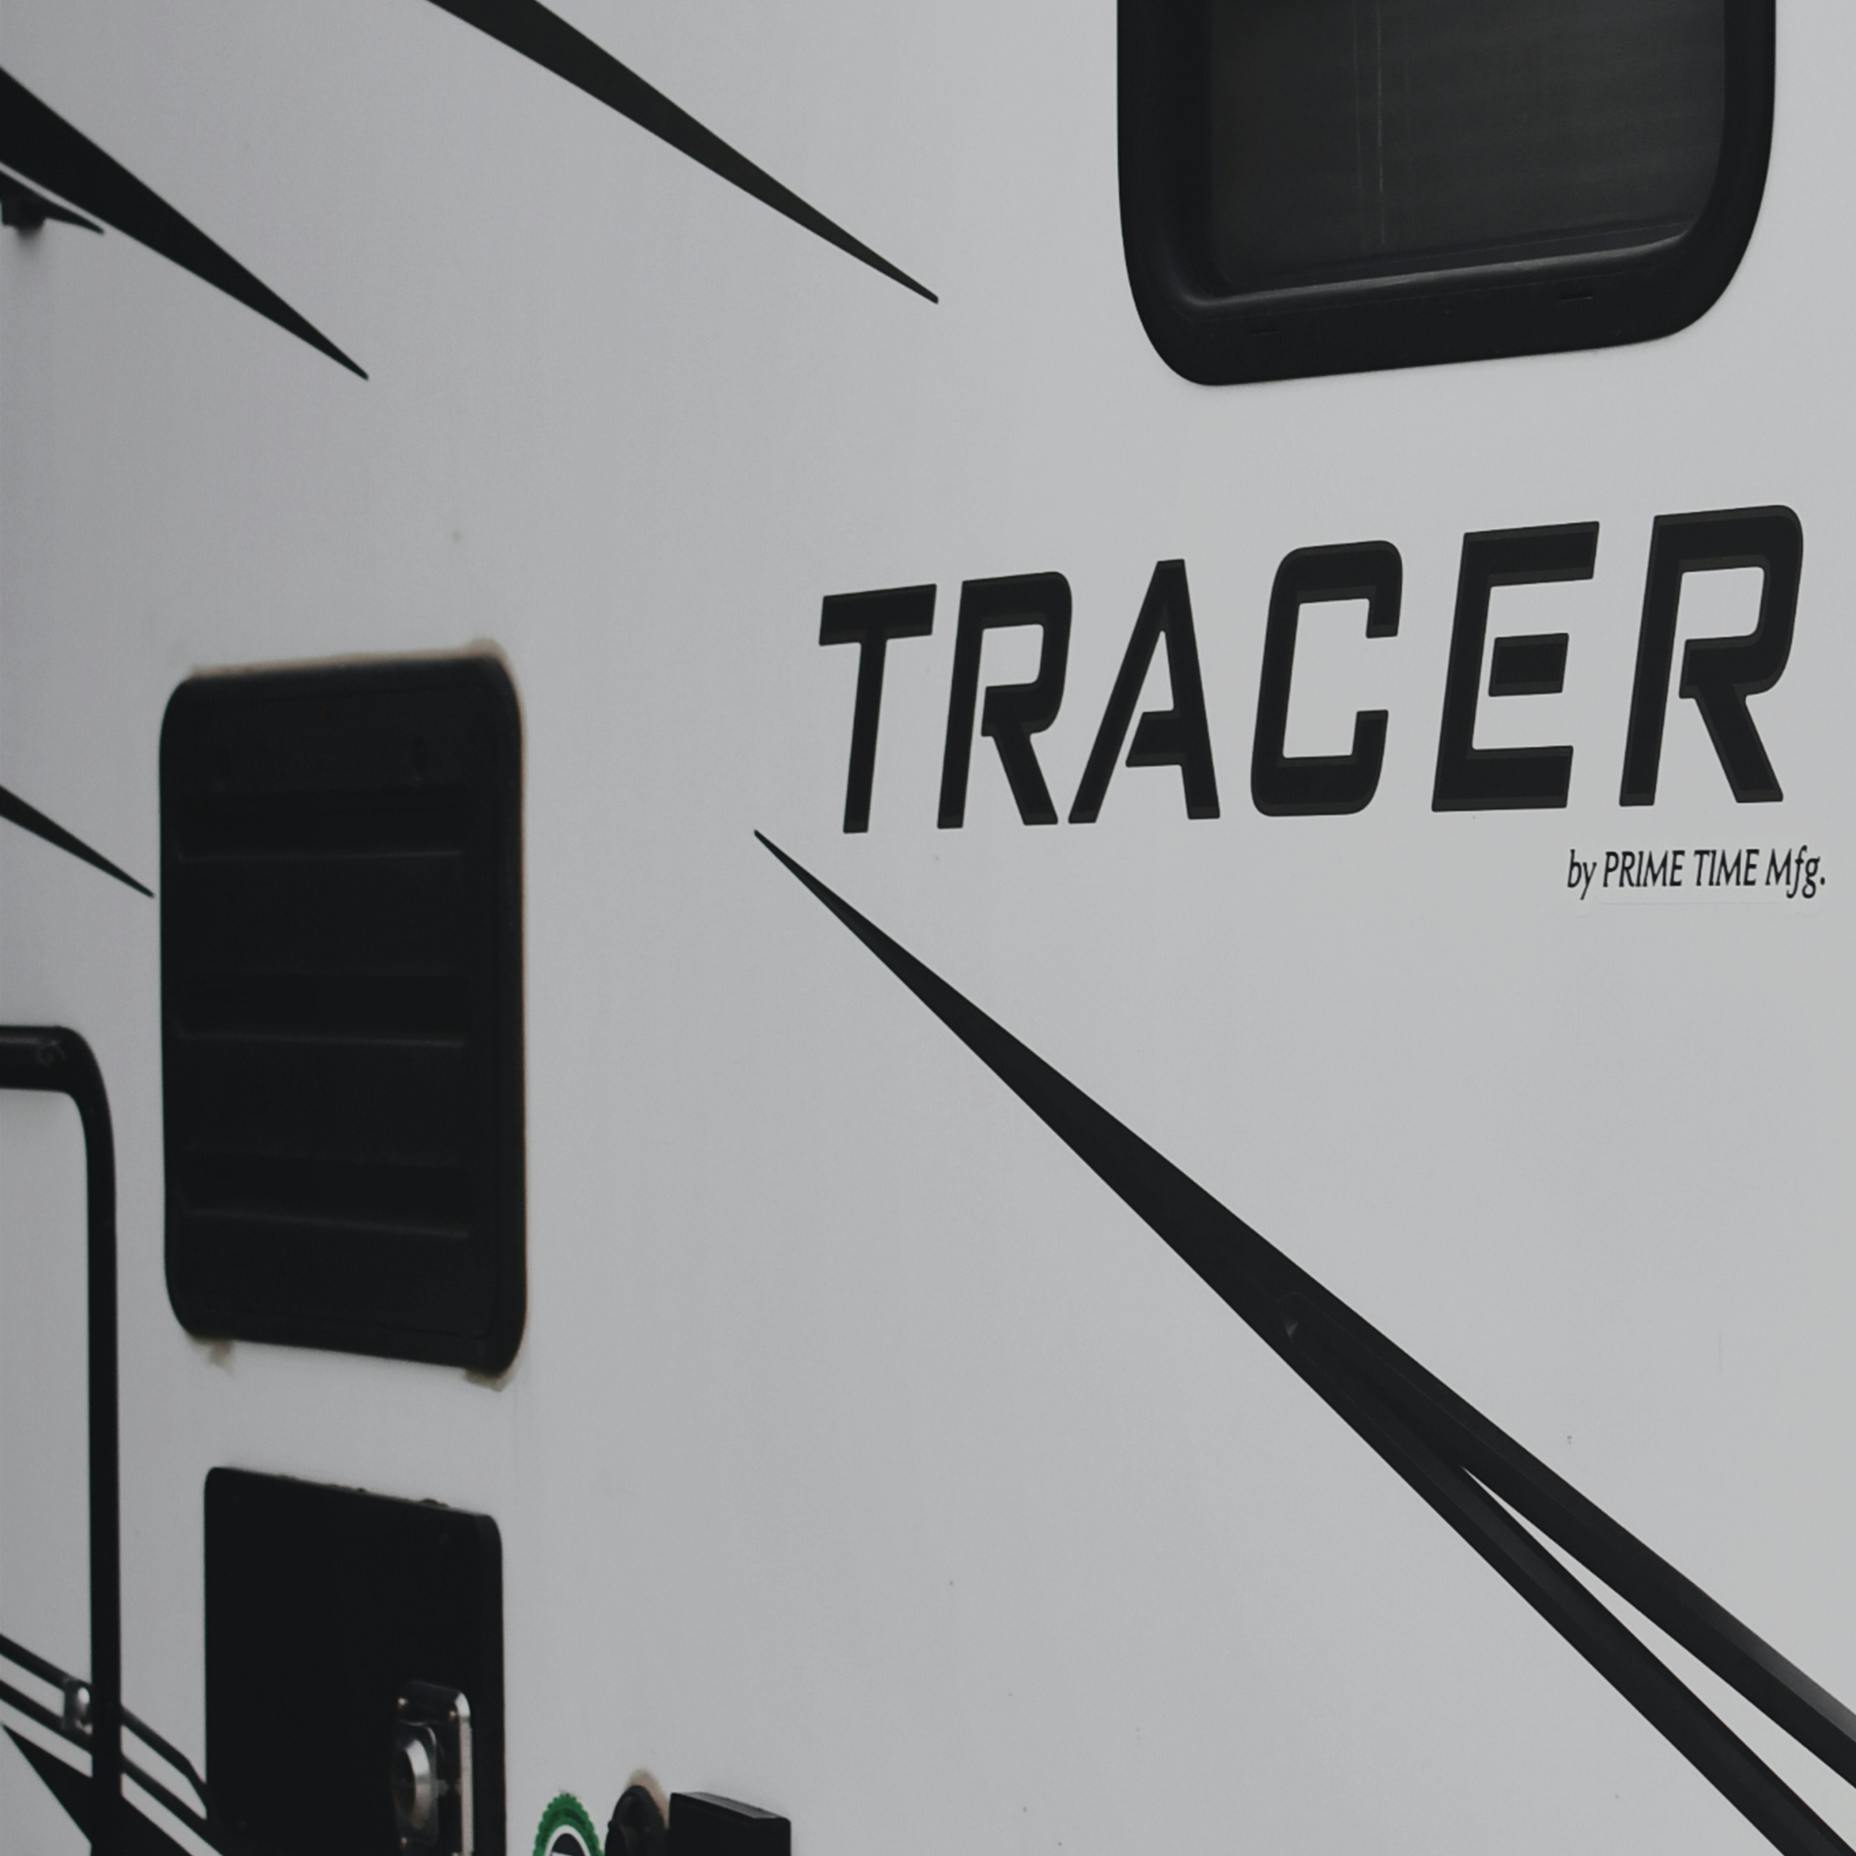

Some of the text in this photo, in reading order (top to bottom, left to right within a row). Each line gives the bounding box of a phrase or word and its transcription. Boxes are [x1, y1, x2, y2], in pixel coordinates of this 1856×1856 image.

[819, 505, 1803, 834] TRACER
[1567, 844, 1826, 901] by PRIME TIME Mfg.
